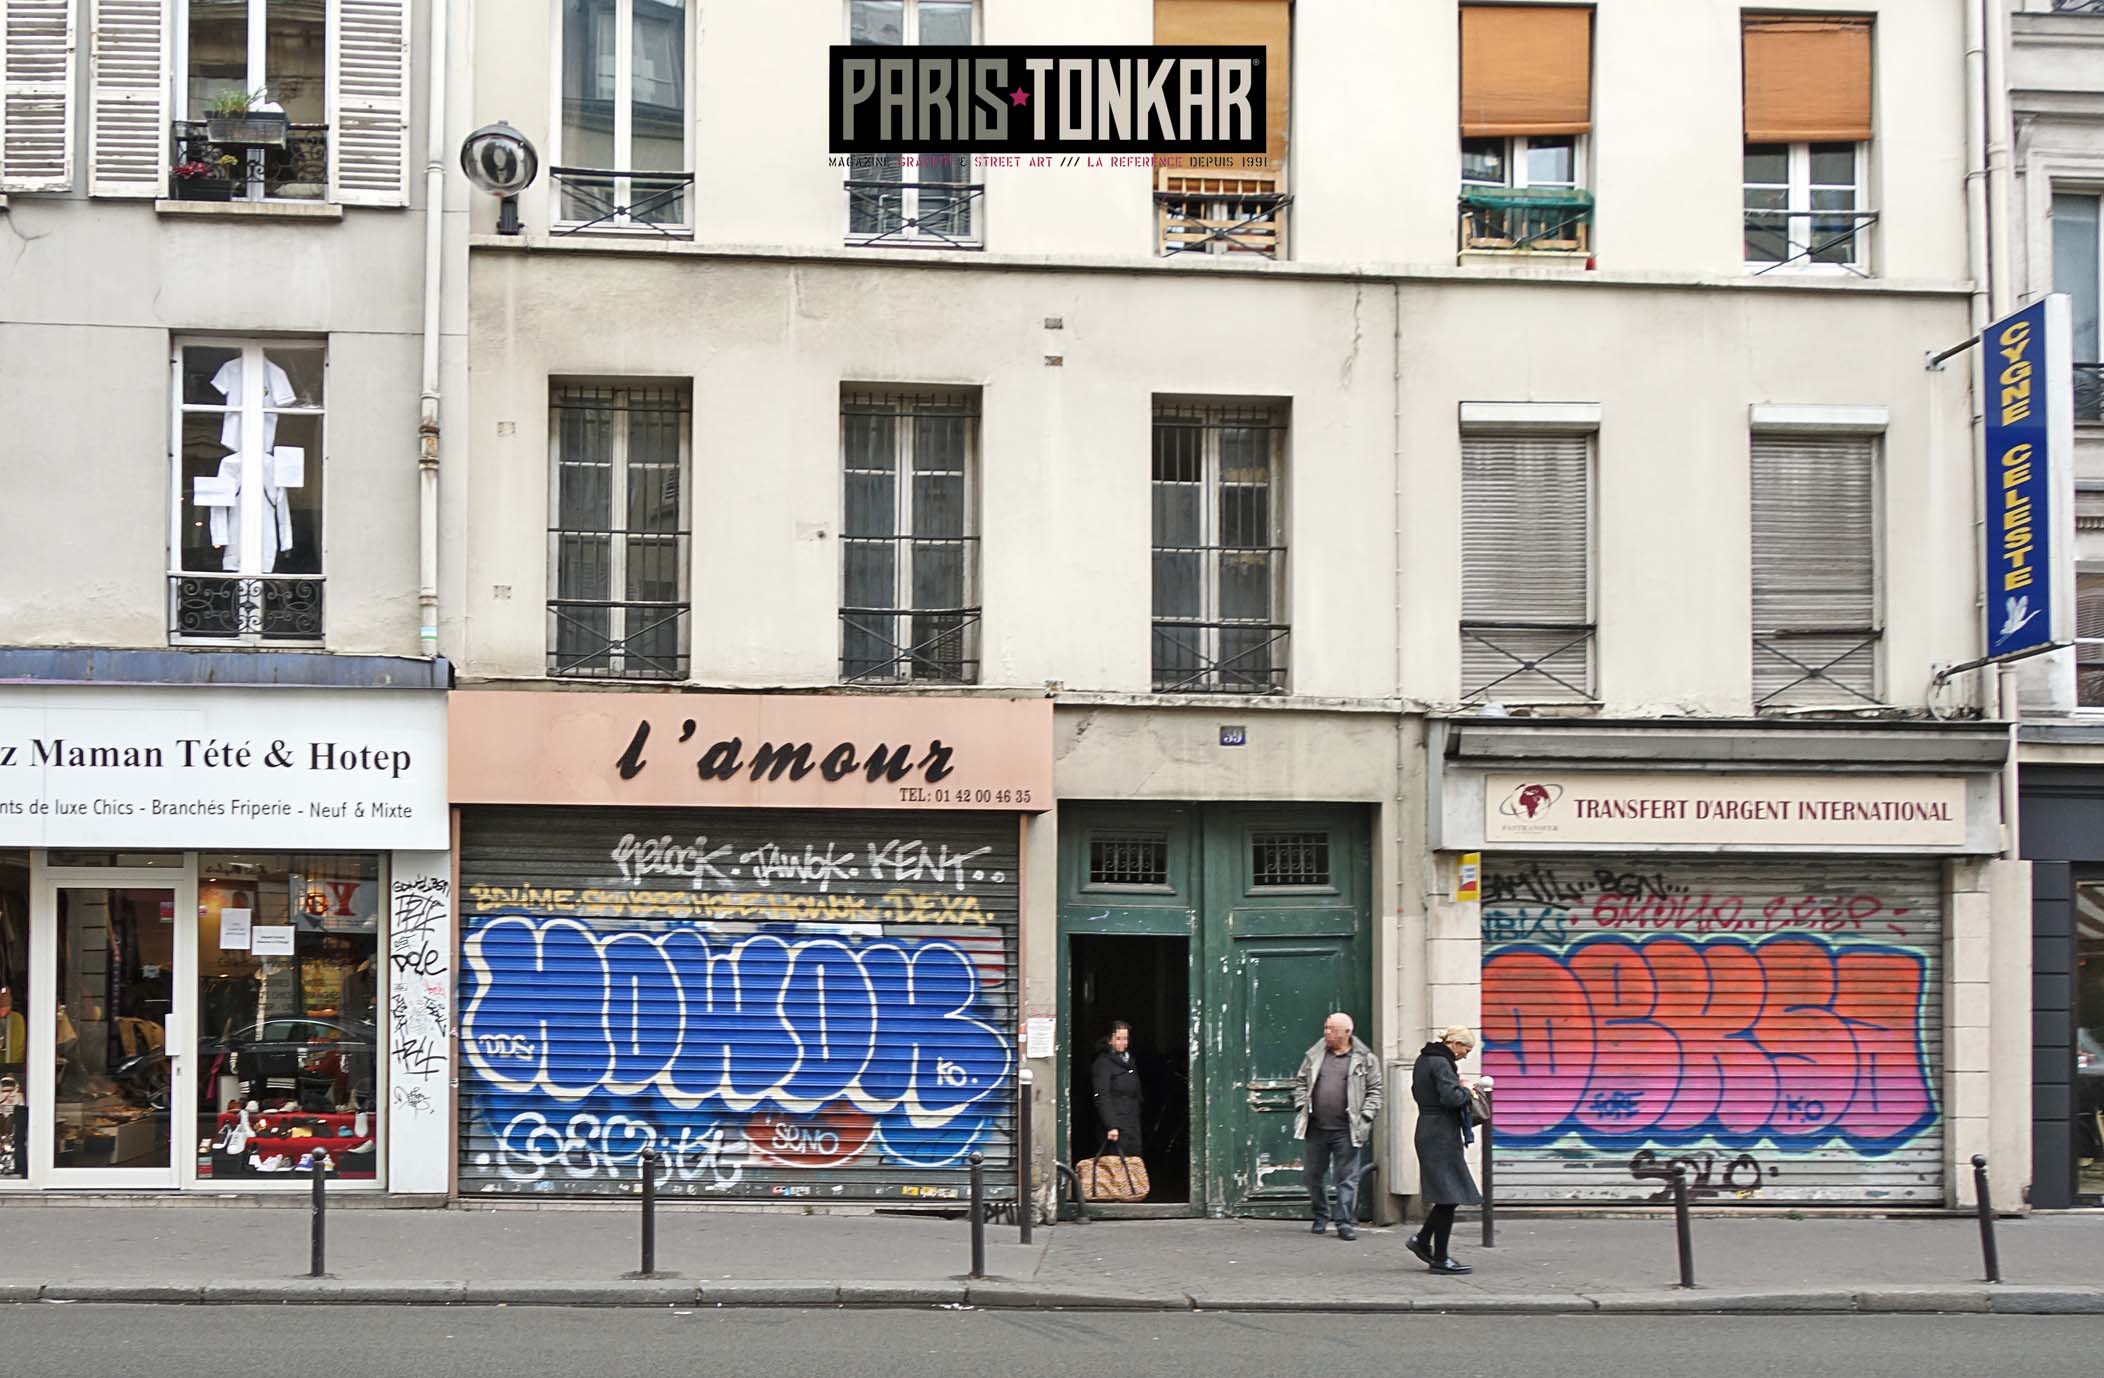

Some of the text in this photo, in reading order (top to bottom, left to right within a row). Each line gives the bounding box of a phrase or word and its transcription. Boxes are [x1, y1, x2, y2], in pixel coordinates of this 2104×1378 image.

[2000, 320, 2033, 426] CYGNE
[2002, 442, 2033, 591] CELESTE
[29, 739, 163, 768] Maman
[176, 739, 252, 768] Tété
[264, 739, 294, 768] &
[309, 741, 411, 779] Hotep
[29, 799, 49, 815] de
[55, 799, 88, 816] luxe
[93, 799, 134, 816] Chics
[152, 799, 225, 816] Branchés
[231, 799, 292, 819] Friperie
[310, 801, 347, 818] Neuf
[354, 801, 365, 818] &
[371, 802, 412, 818] Mixte
[899, 787, 1031, 804] TEL: 01 42 00 46 35
[1573, 799, 1953, 821] TRANSFERT D'ARGENT INTERNATIONAL
